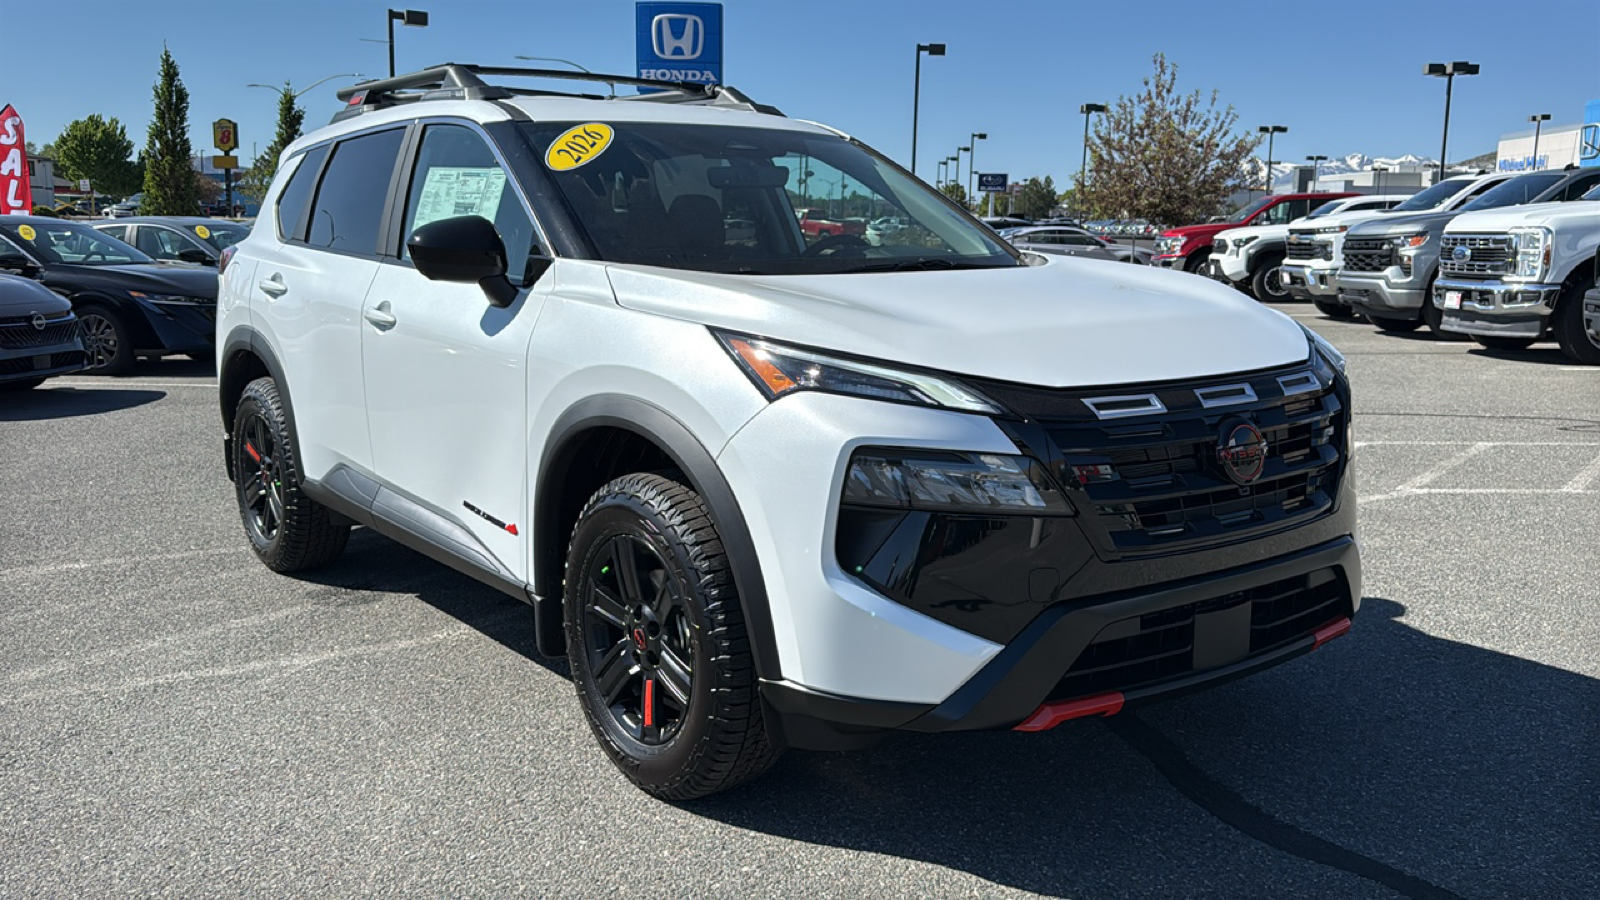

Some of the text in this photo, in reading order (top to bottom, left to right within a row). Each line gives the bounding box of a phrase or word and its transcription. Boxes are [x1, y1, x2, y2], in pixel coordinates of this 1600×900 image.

[640, 69, 717, 81] HONDA
[219, 129, 231, 145] 8
[556, 126, 604, 164] 2026
[0, 116, 30, 216] SAL
